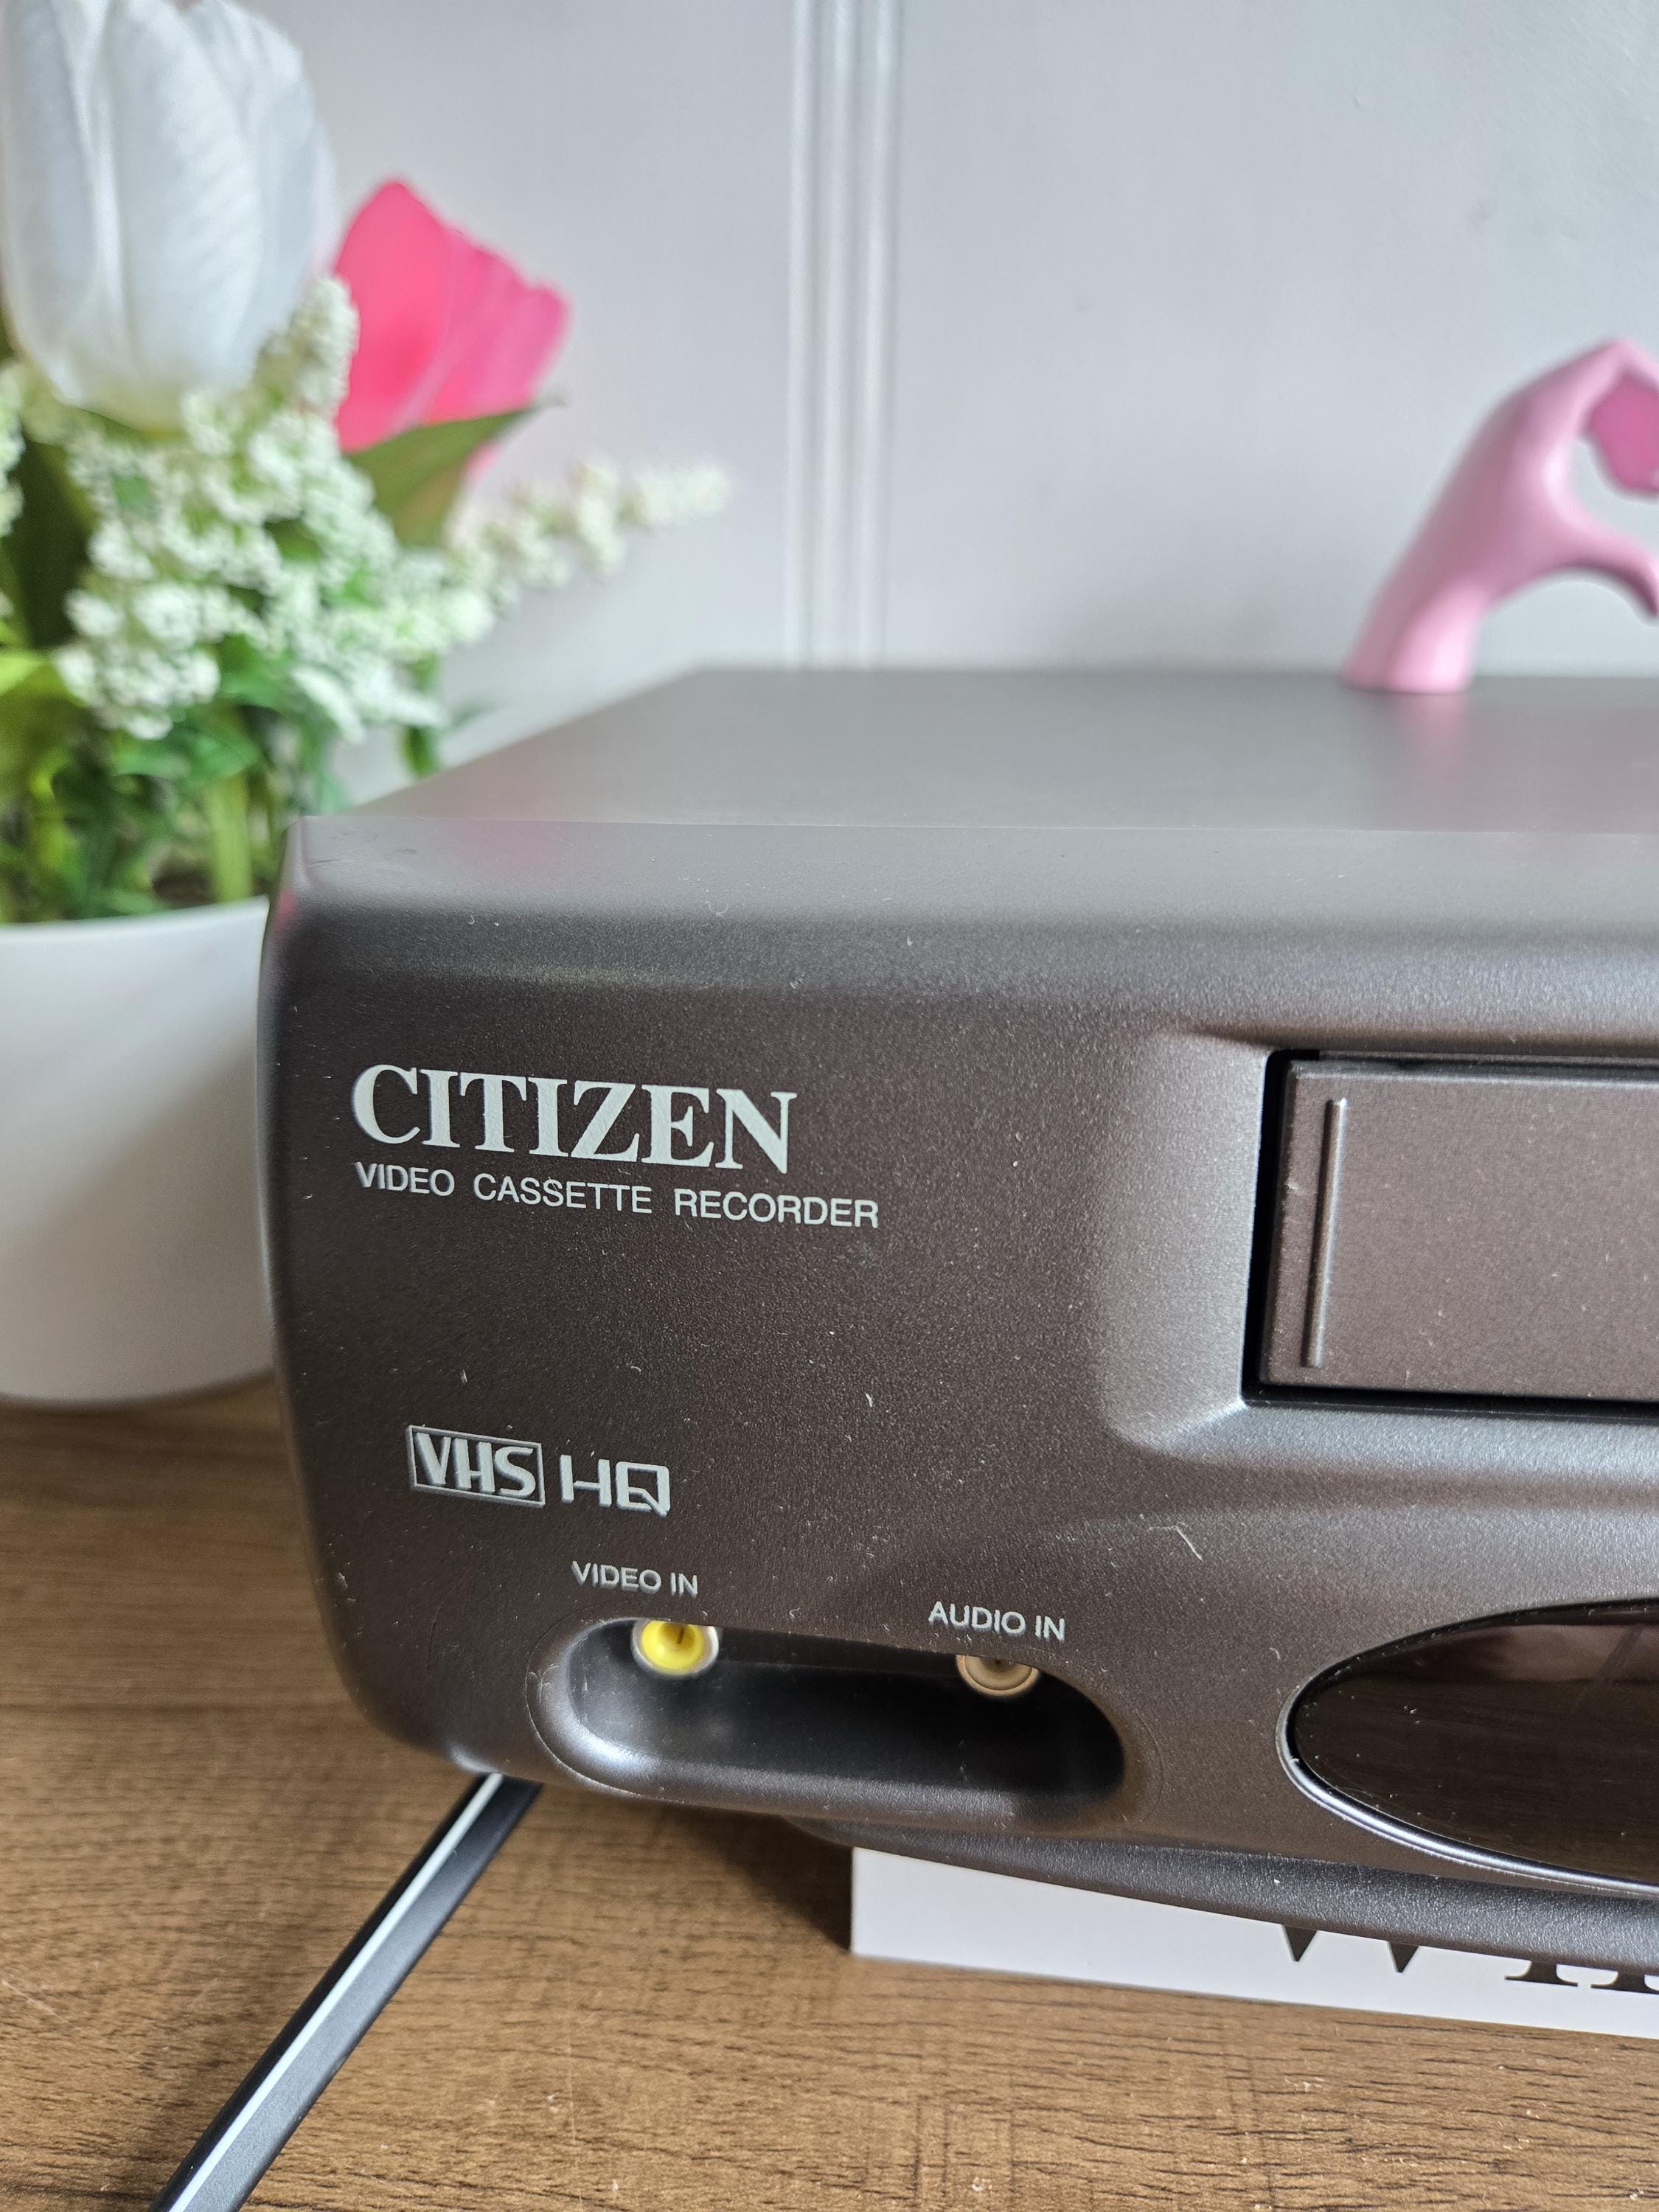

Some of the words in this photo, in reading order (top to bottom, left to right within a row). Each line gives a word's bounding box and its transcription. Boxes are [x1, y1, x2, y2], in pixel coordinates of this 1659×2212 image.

[352, 1064, 798, 1174] CITIZEN
[354, 1161, 455, 1197] VIDEO
[473, 1172, 653, 1214] CASSETTE
[674, 1188, 880, 1229] RECORDER
[415, 1432, 536, 1499] VHS
[560, 1454, 670, 1517] HQ
[571, 1559, 662, 1595] VIDEO
[669, 1572, 699, 1599] IN
[928, 1601, 1026, 1635] AUDIO
[1035, 1613, 1066, 1642] IN
